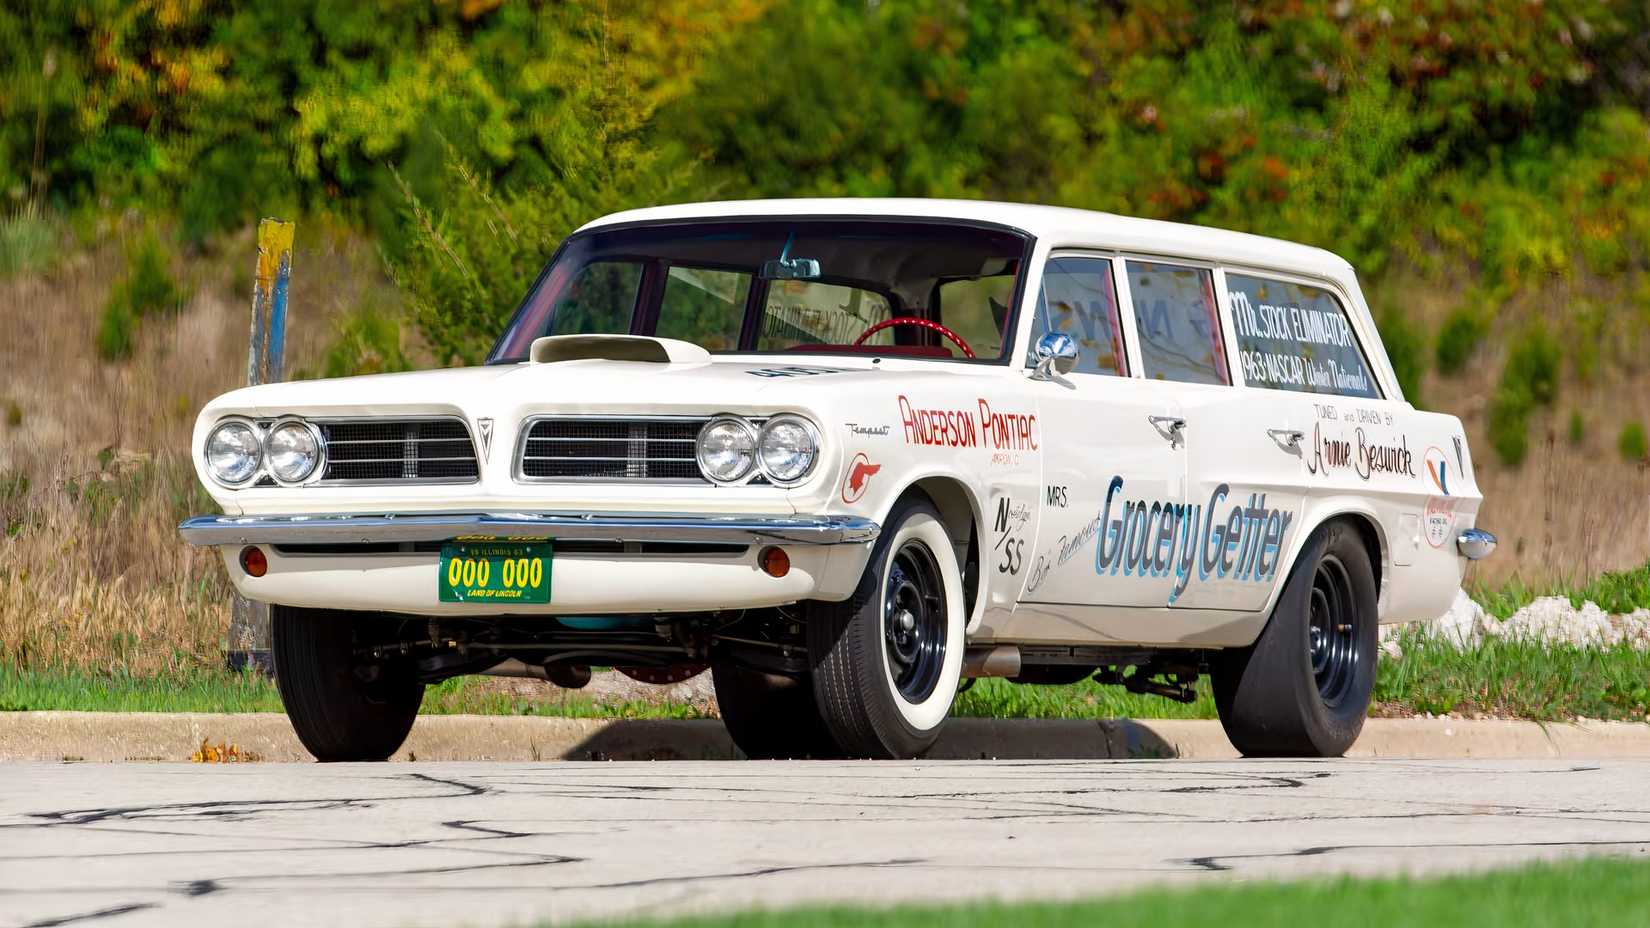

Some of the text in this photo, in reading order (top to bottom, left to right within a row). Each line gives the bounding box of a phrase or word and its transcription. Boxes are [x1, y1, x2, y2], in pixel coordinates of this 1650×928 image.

[1259, 305, 1293, 341] STOCK
[1290, 308, 1352, 347] ELIMINATOR
[844, 423, 890, 439] Tempest
[898, 394, 1039, 451] ANDERSON PONTIAC
[1313, 403, 1338, 421] TUNED
[1356, 408, 1382, 426] DRIVEN
[1384, 411, 1393, 426] BY
[1307, 422, 1416, 480] Arnie Beswick
[1095, 475, 1293, 605] Grocery Getter
[448, 557, 542, 588] 000 000
[467, 589, 522, 597] LAND OF LINCOLN
